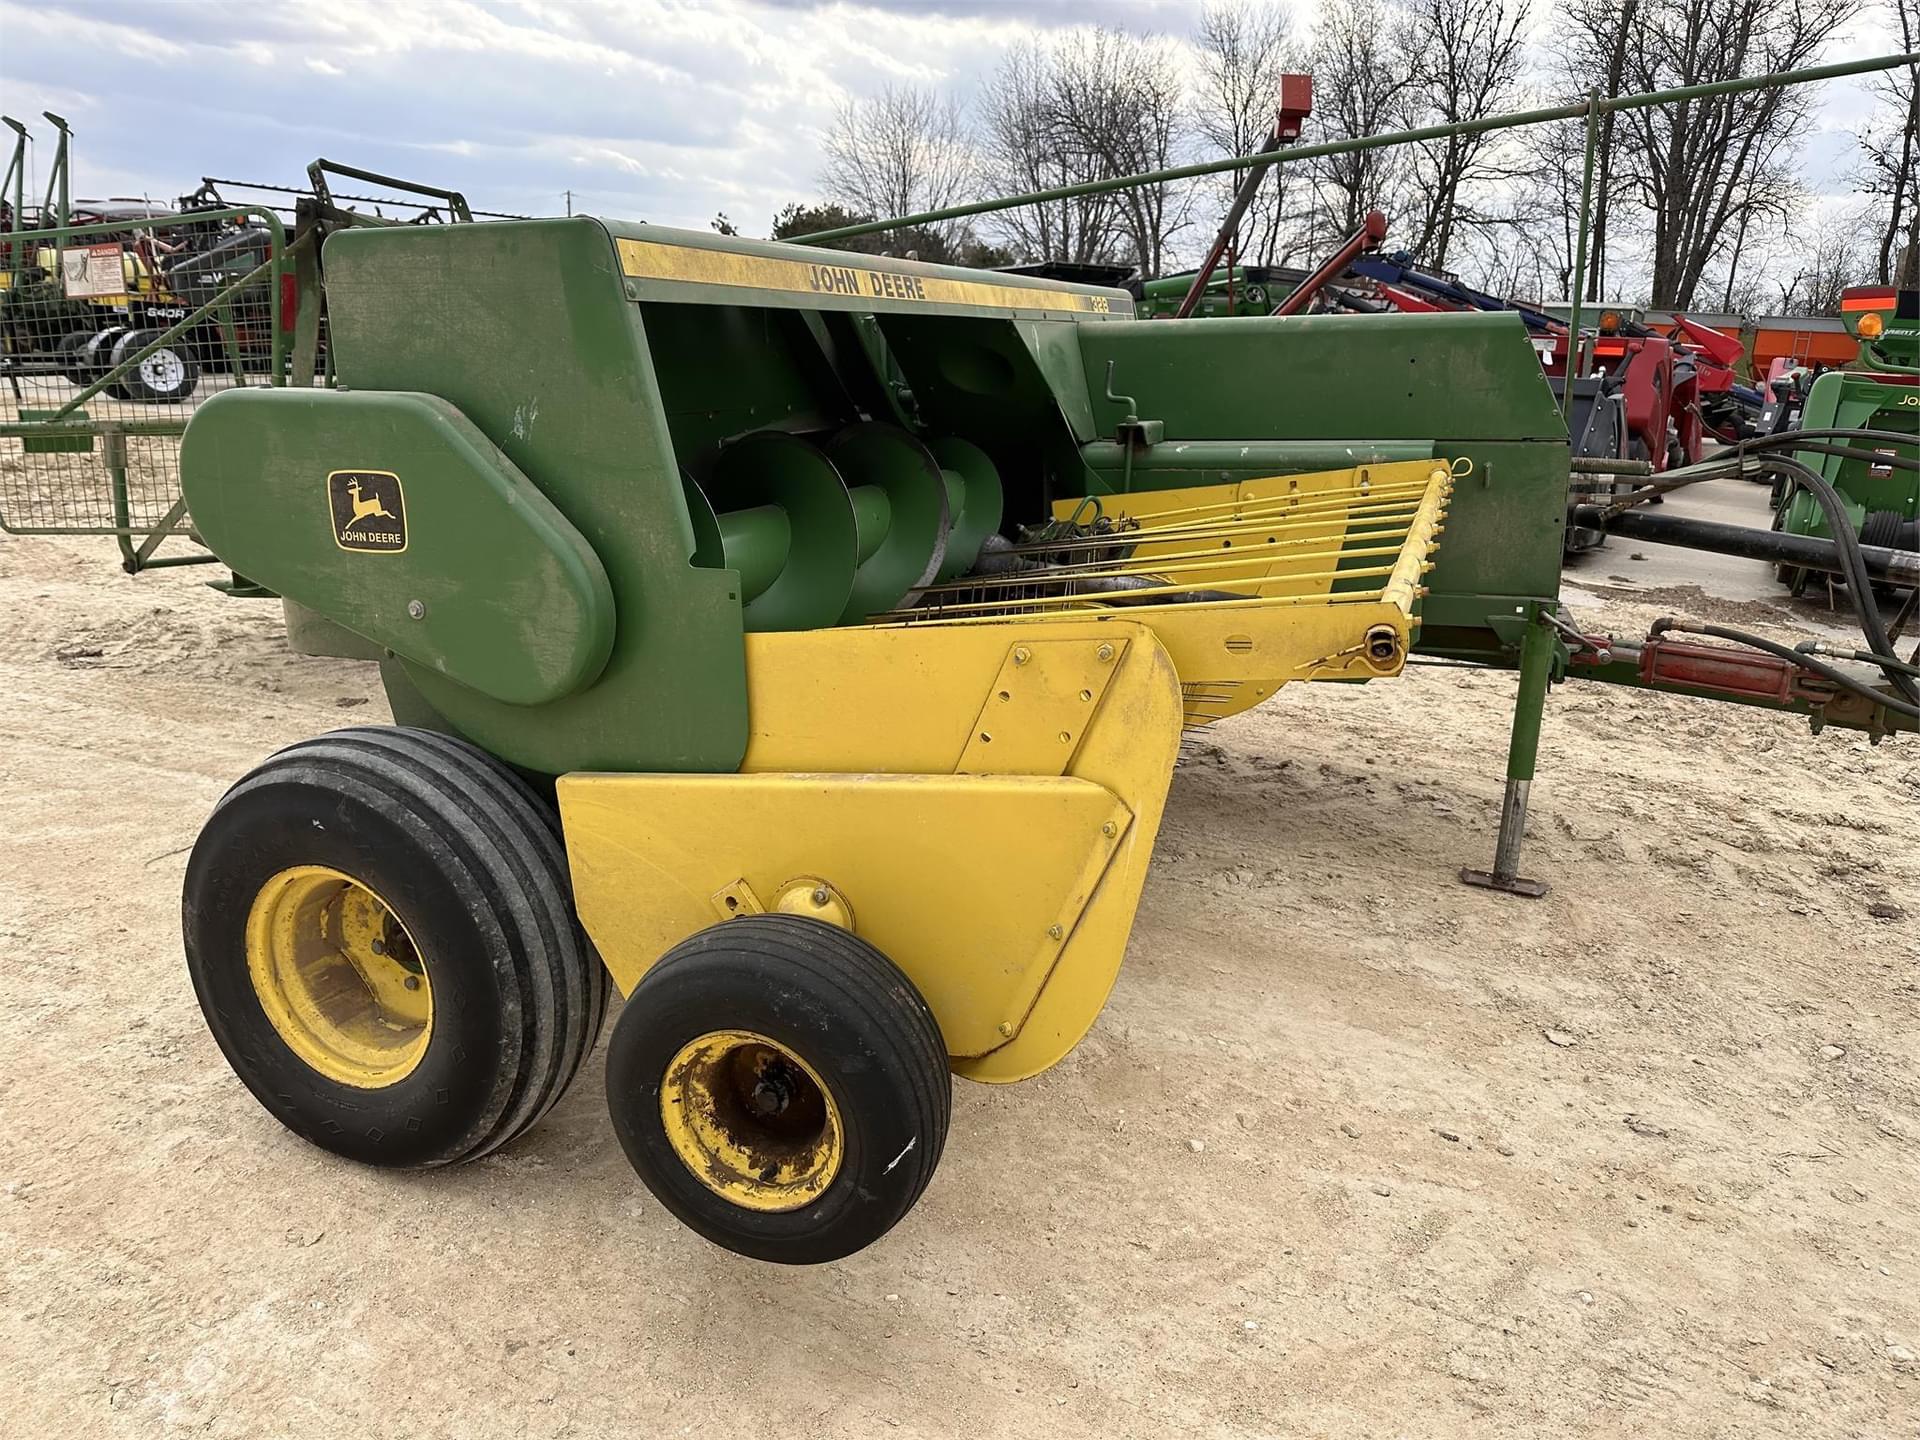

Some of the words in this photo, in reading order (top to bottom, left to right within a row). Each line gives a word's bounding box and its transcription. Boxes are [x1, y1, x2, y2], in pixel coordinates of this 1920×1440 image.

[810, 266, 860, 294] JOHN
[870, 273, 925, 299] DEERE
[340, 531, 366, 542] JOHN
[369, 532, 401, 544] DEERE
